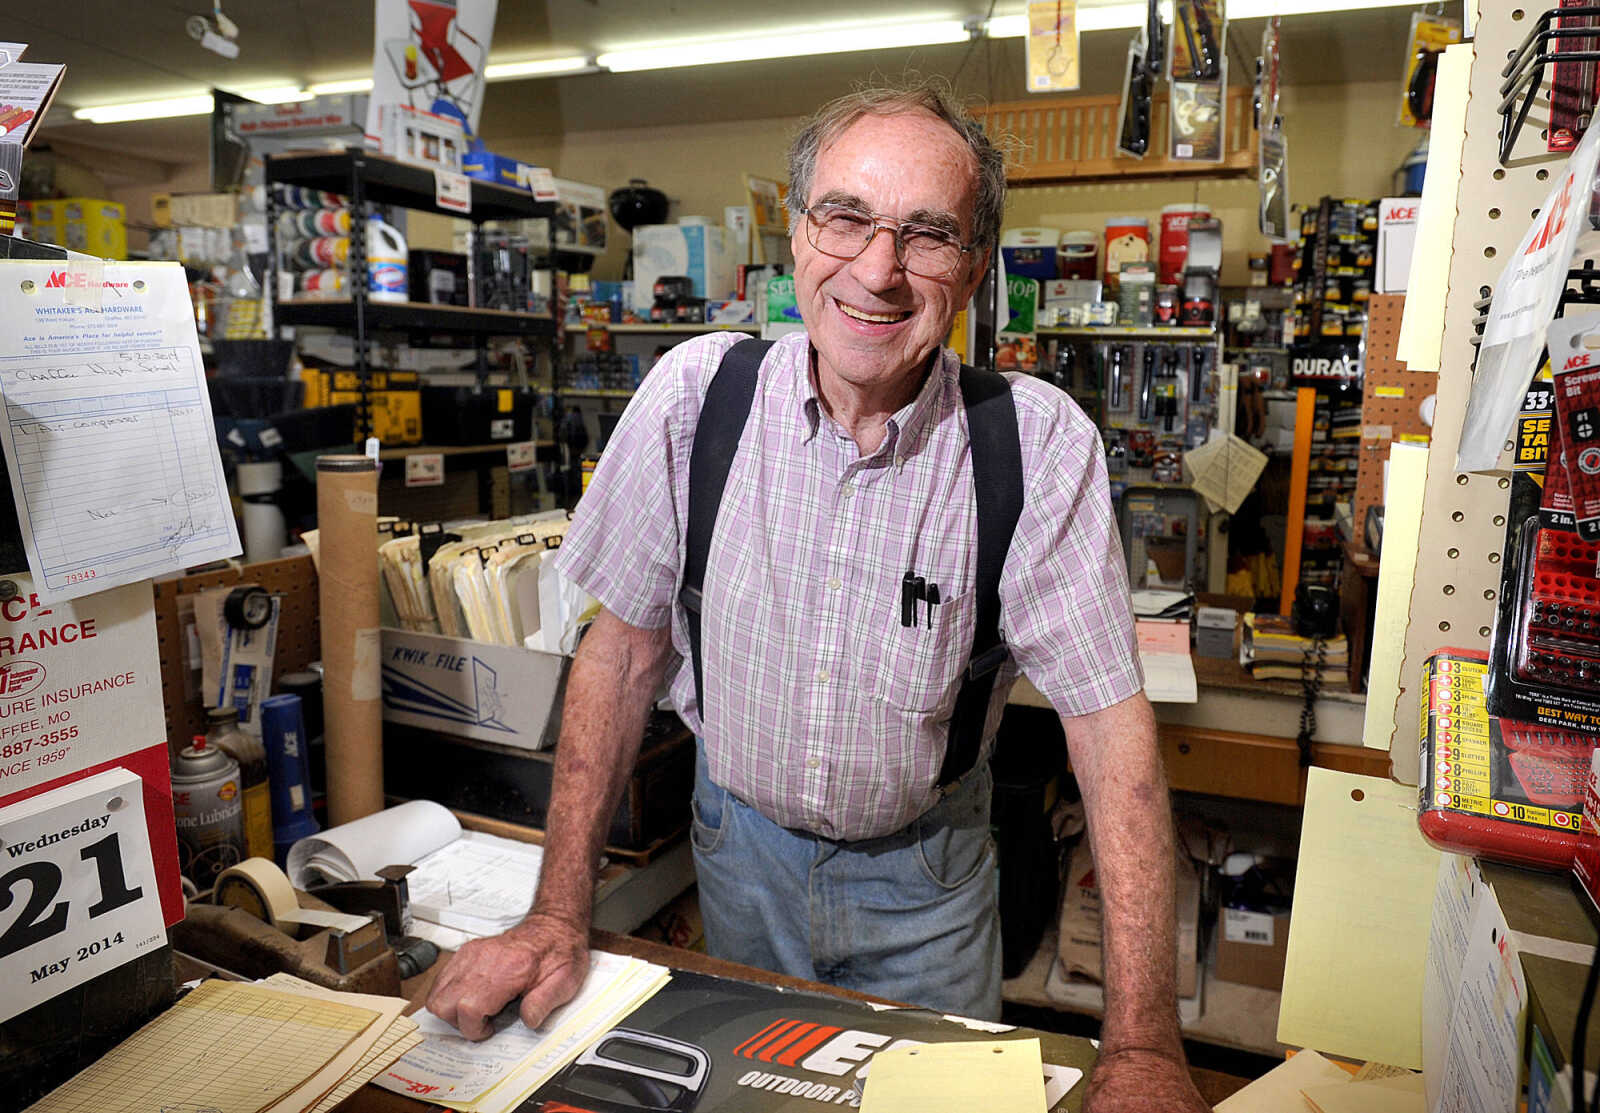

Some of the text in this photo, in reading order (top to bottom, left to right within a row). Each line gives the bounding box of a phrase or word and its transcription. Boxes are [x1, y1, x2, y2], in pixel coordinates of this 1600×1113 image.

[1385, 206, 1417, 220] ACE
[45, 270, 87, 288] ACE
[35, 307, 82, 315] WHITAKER'S
[102, 305, 143, 313] HARDWARE
[1293, 358, 1360, 377] DURAC
[1563, 353, 1590, 370] ACE
[1566, 386, 1581, 397] Bit
[1525, 391, 1549, 410] 33
[1523, 419, 1551, 433] SE
[1522, 434, 1548, 447] TA
[1551, 514, 1574, 525] 2 in.
[1588, 522, 1597, 532] 2
[65, 569, 97, 585] 79343
[0, 618, 97, 658] RANCE
[392, 647, 468, 673] KWIK FILE
[1454, 663, 1461, 673] 3
[1454, 676, 1461, 687] 3
[41, 671, 136, 707] INSURANCE
[1454, 690, 1461, 701] 3
[1454, 705, 1461, 716] 4
[1537, 706, 1562, 718] BEST
[1564, 711, 1588, 723] WAY
[0, 710, 71, 739] FFEE, MO
[1454, 719, 1461, 730] 4
[1538, 716, 1562, 724] DEER
[1454, 734, 1461, 745] 4
[1453, 748, 1461, 760] 9
[1454, 764, 1461, 776] 8
[1454, 779, 1461, 792] 8
[1453, 795, 1461, 808] 9
[1511, 806, 1526, 820] 10
[1571, 815, 1580, 829] 6
[6, 813, 112, 858] Wednesday
[0, 832, 144, 959] 21
[30, 931, 125, 984] May 2014
[737, 1070, 841, 1103] OUTDOOR
